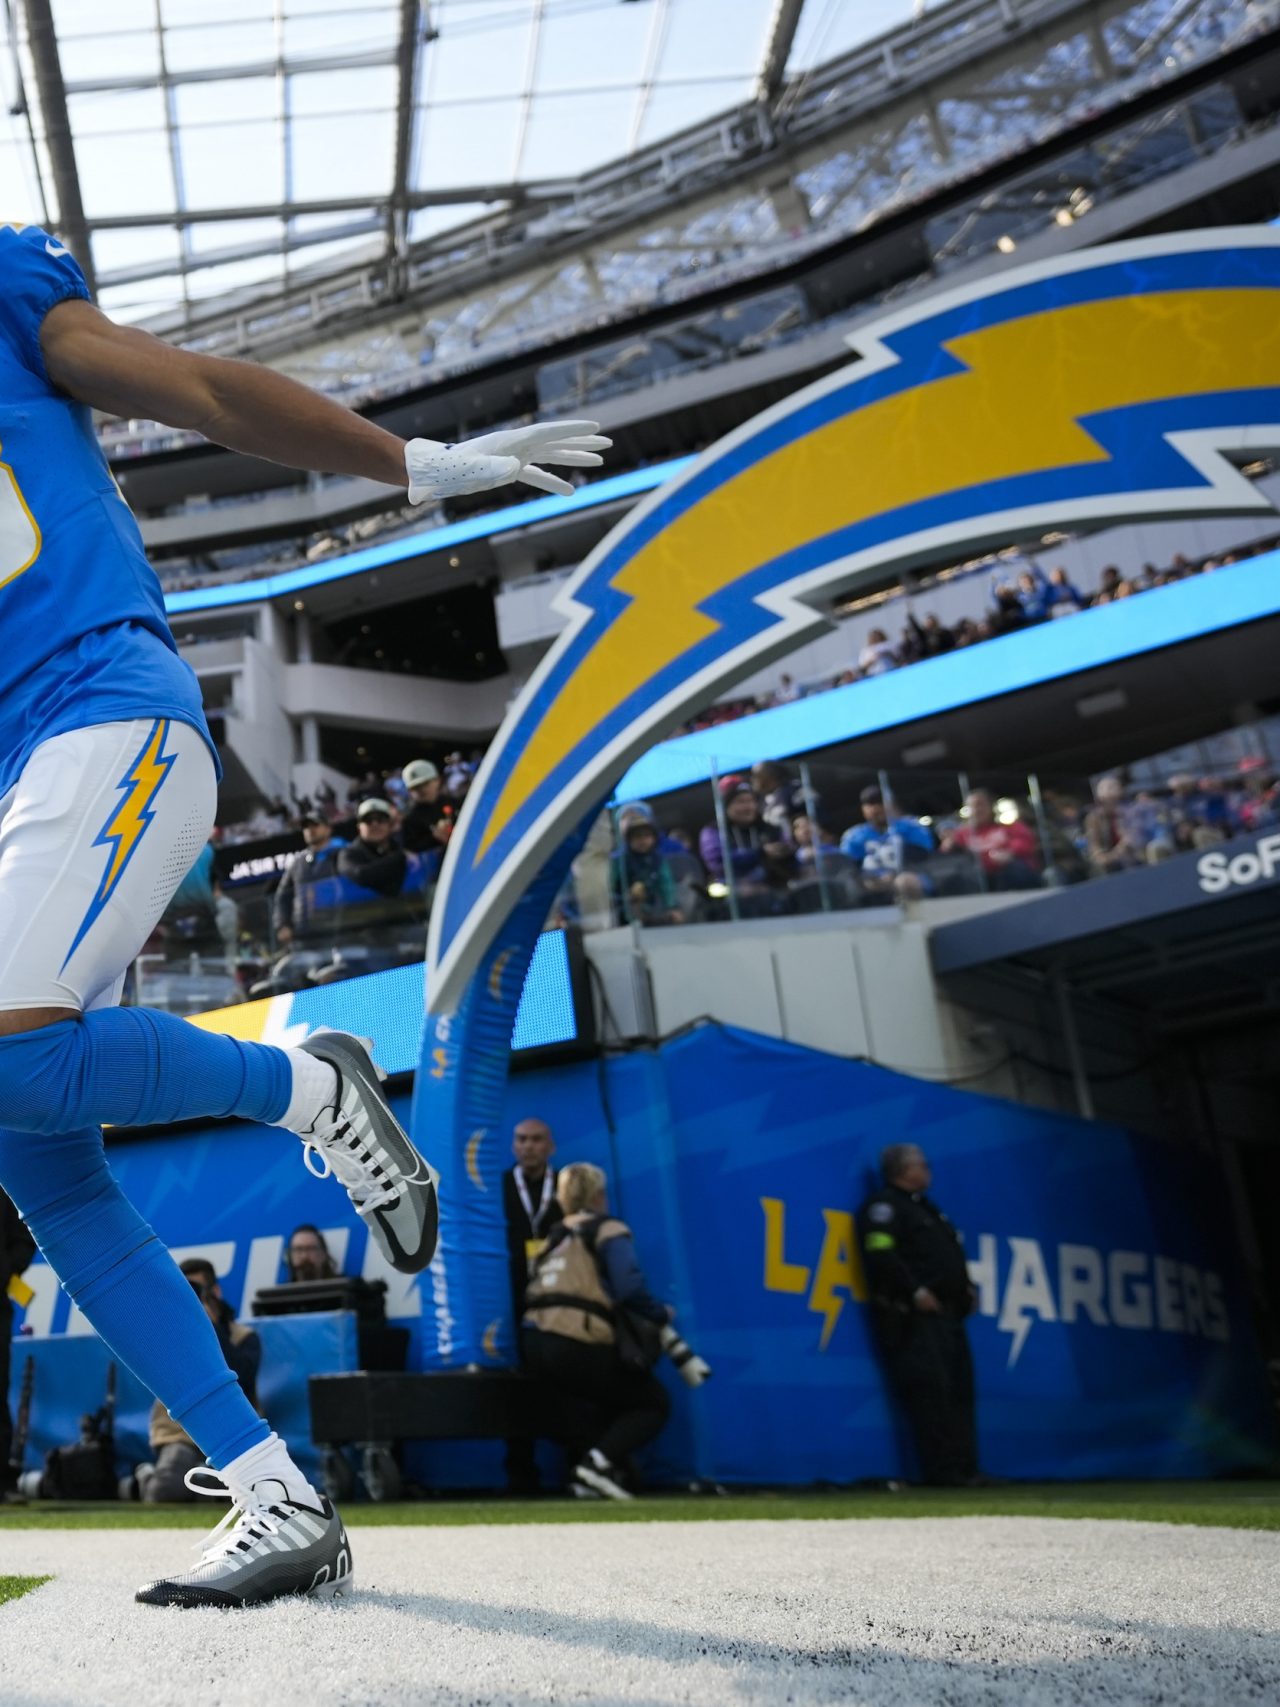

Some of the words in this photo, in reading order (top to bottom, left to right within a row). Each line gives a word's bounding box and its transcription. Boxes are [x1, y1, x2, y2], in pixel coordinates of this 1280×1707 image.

[1197, 832, 1280, 893] SoF
[430, 1250, 455, 1355] CHARGE
[760, 1196, 866, 1353] LA
[957, 1231, 1231, 1371] HARGERS
